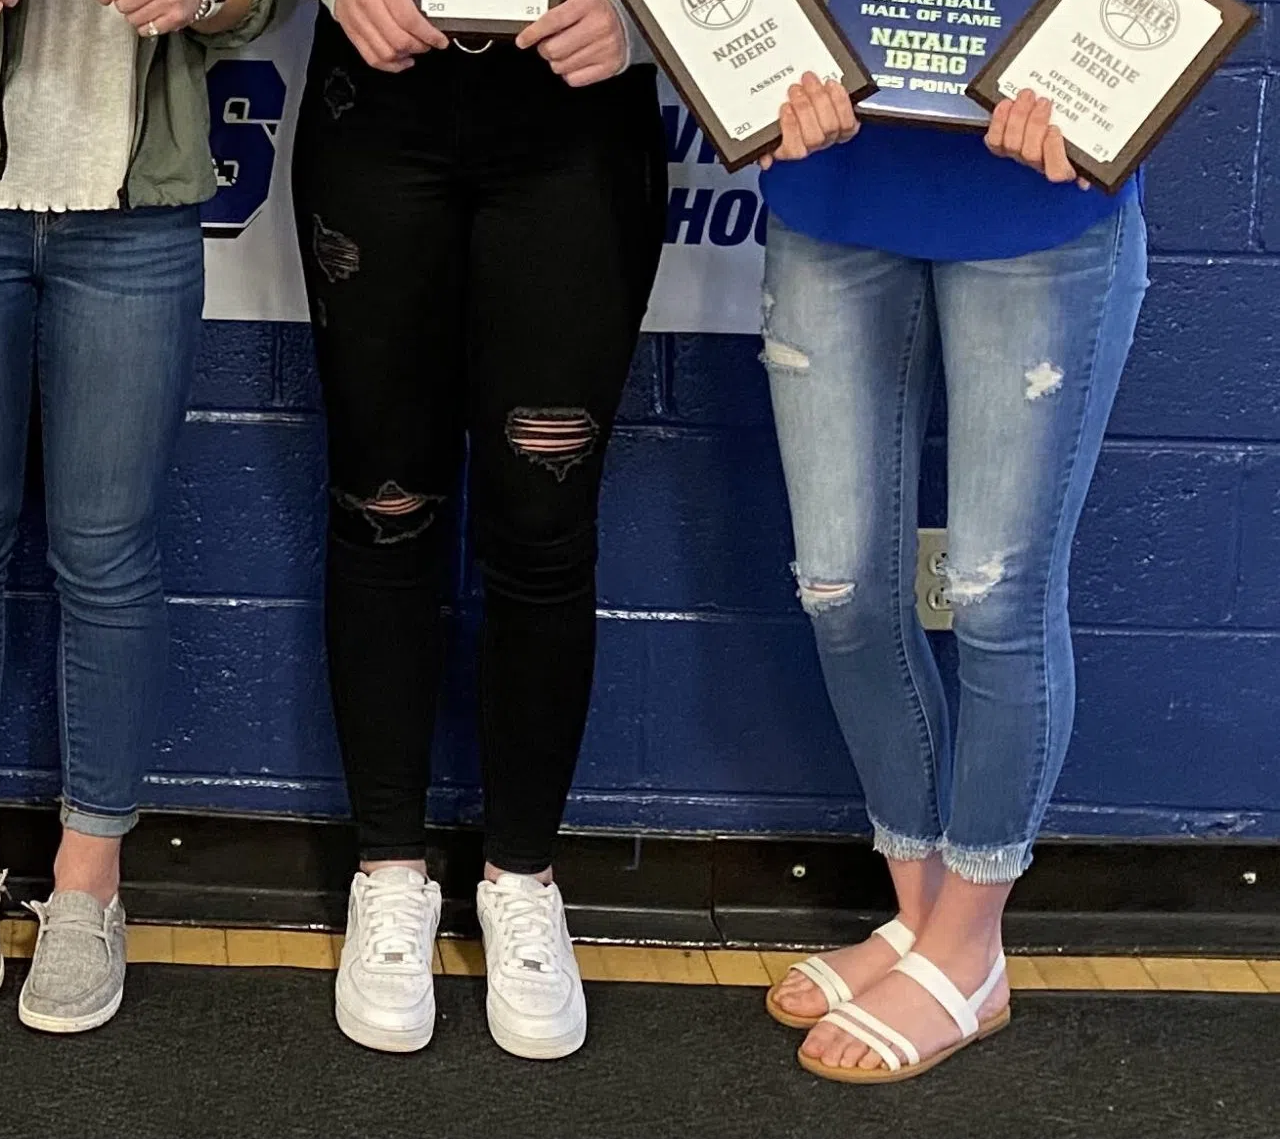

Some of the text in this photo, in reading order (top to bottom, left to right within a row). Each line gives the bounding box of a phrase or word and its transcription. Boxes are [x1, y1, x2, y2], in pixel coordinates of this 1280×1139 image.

[428, 2, 541, 15] 20 21
[860, 3, 1002, 27] HALL OF FAME
[712, 17, 779, 63] NATALIE
[729, 36, 777, 70] IBERG
[870, 26, 987, 56] NATALIE
[884, 49, 967, 75] IBERG
[1070, 52, 1120, 89] IBERG
[1071, 31, 1141, 84] NATALIE
[749, 65, 795, 95] ASSISTS
[909, 77, 968, 96] POINT
[1049, 69, 1109, 113] OFFENSIVE
[1029, 70, 1114, 132] PLAYER OF THE
[734, 121, 753, 136] 20
[1092, 144, 1109, 158] 21
